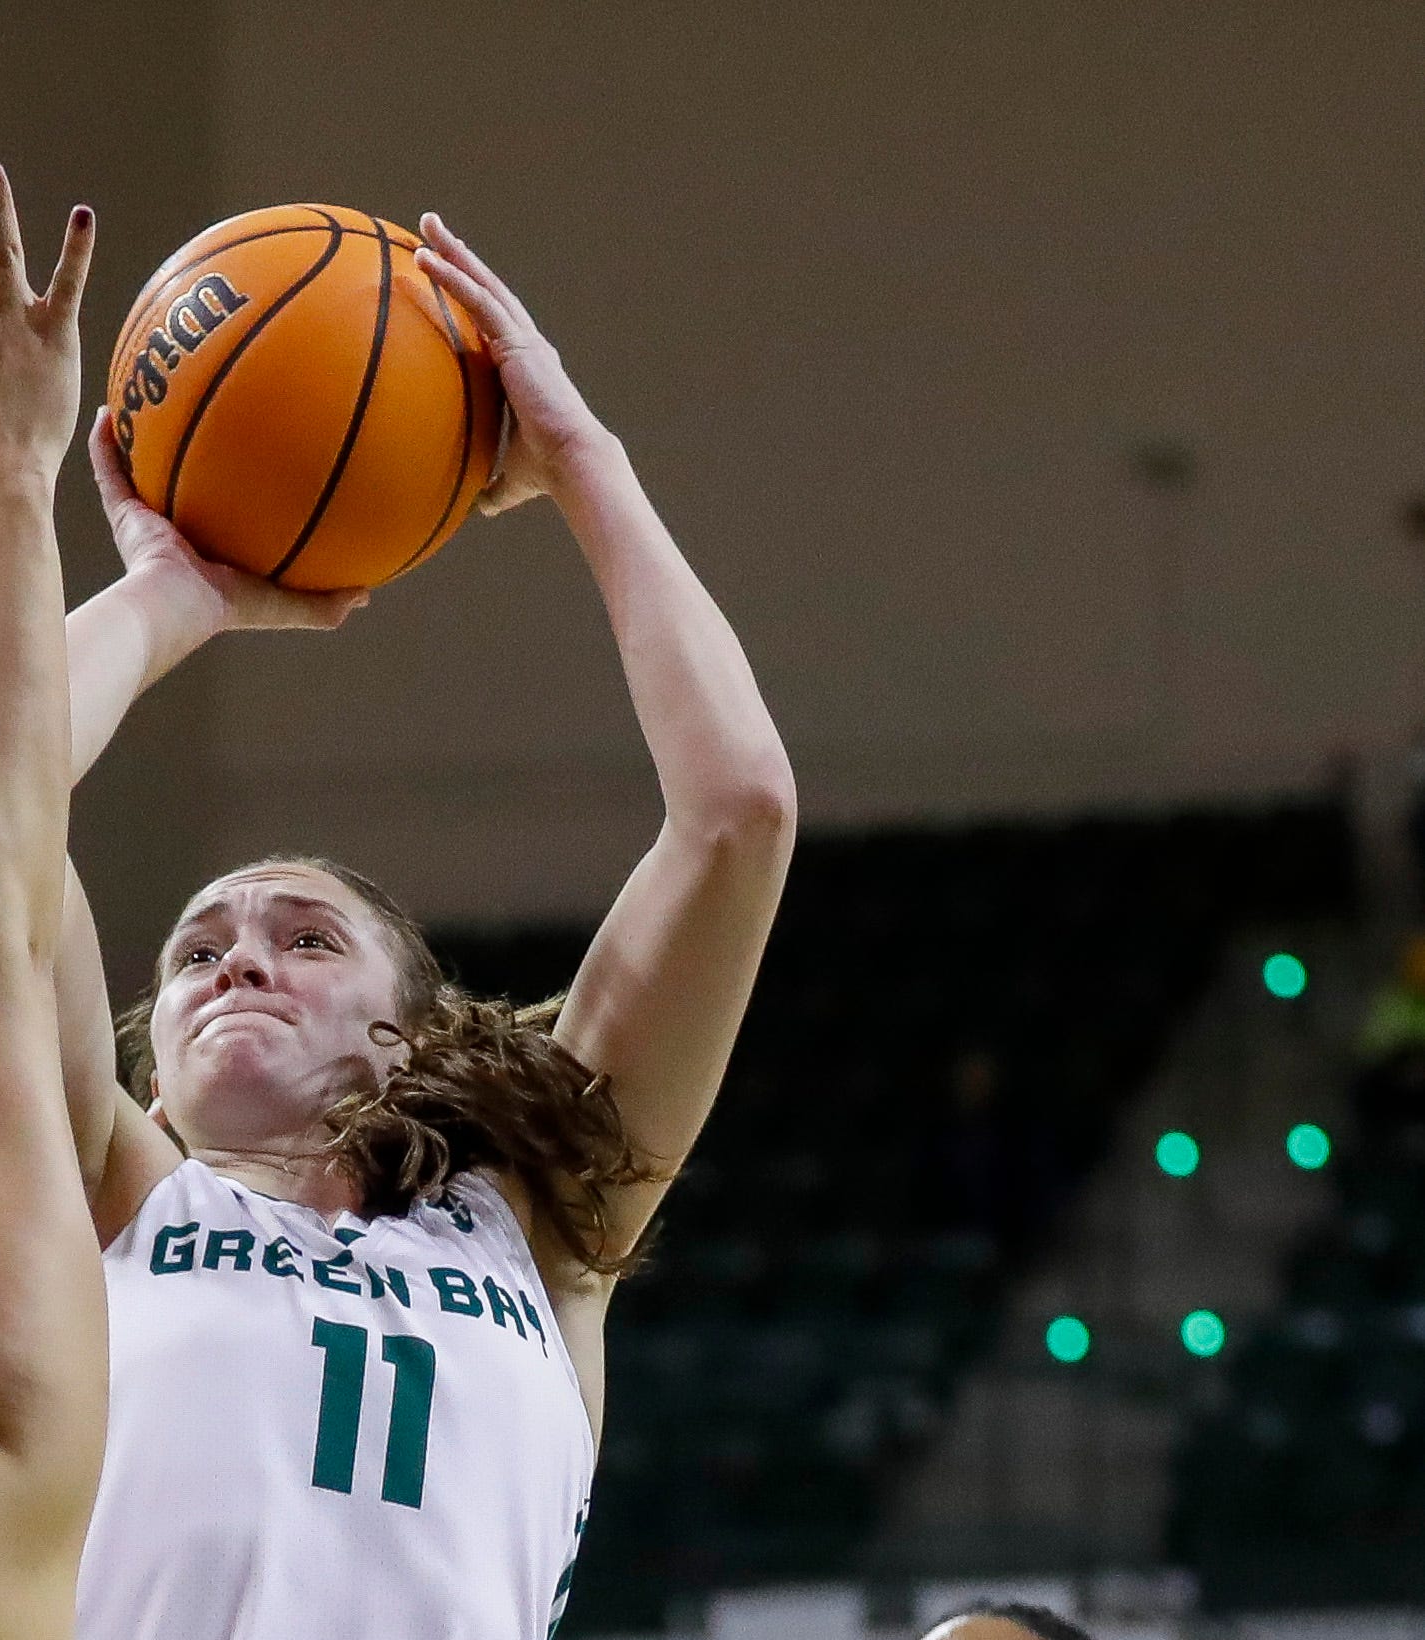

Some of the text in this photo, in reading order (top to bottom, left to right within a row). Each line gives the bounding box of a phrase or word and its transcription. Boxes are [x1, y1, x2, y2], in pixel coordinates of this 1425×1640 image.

[116, 272, 251, 474] Wilso
[150, 1221, 411, 1308] GREEN
[310, 1315, 436, 1511] 11
